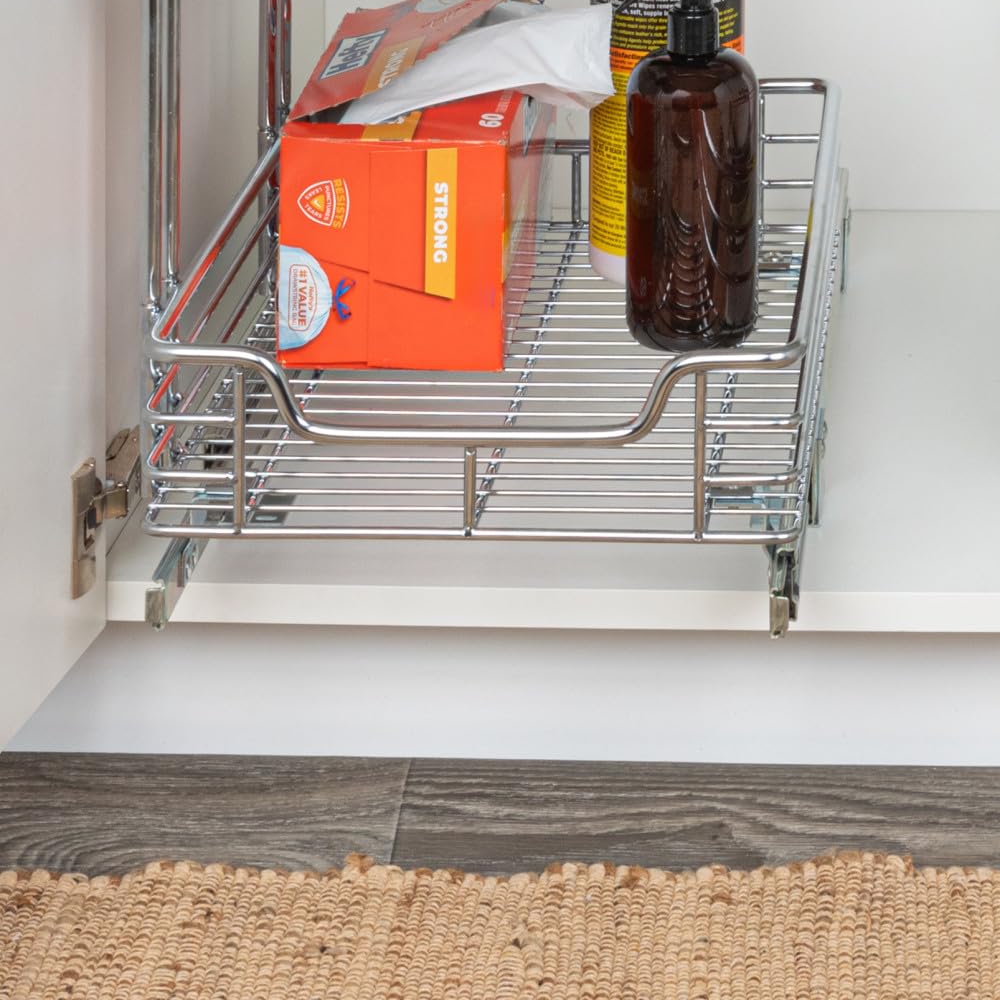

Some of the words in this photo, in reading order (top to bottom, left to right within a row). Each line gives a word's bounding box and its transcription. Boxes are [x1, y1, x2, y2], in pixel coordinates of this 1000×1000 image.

[327, 36, 376, 75] Hefty
[479, 112, 504, 128] 60
[333, 179, 346, 229] RESISTS
[433, 182, 449, 264] STRONG
[299, 270, 307, 283] #1
[298, 285, 307, 326] VALUE
